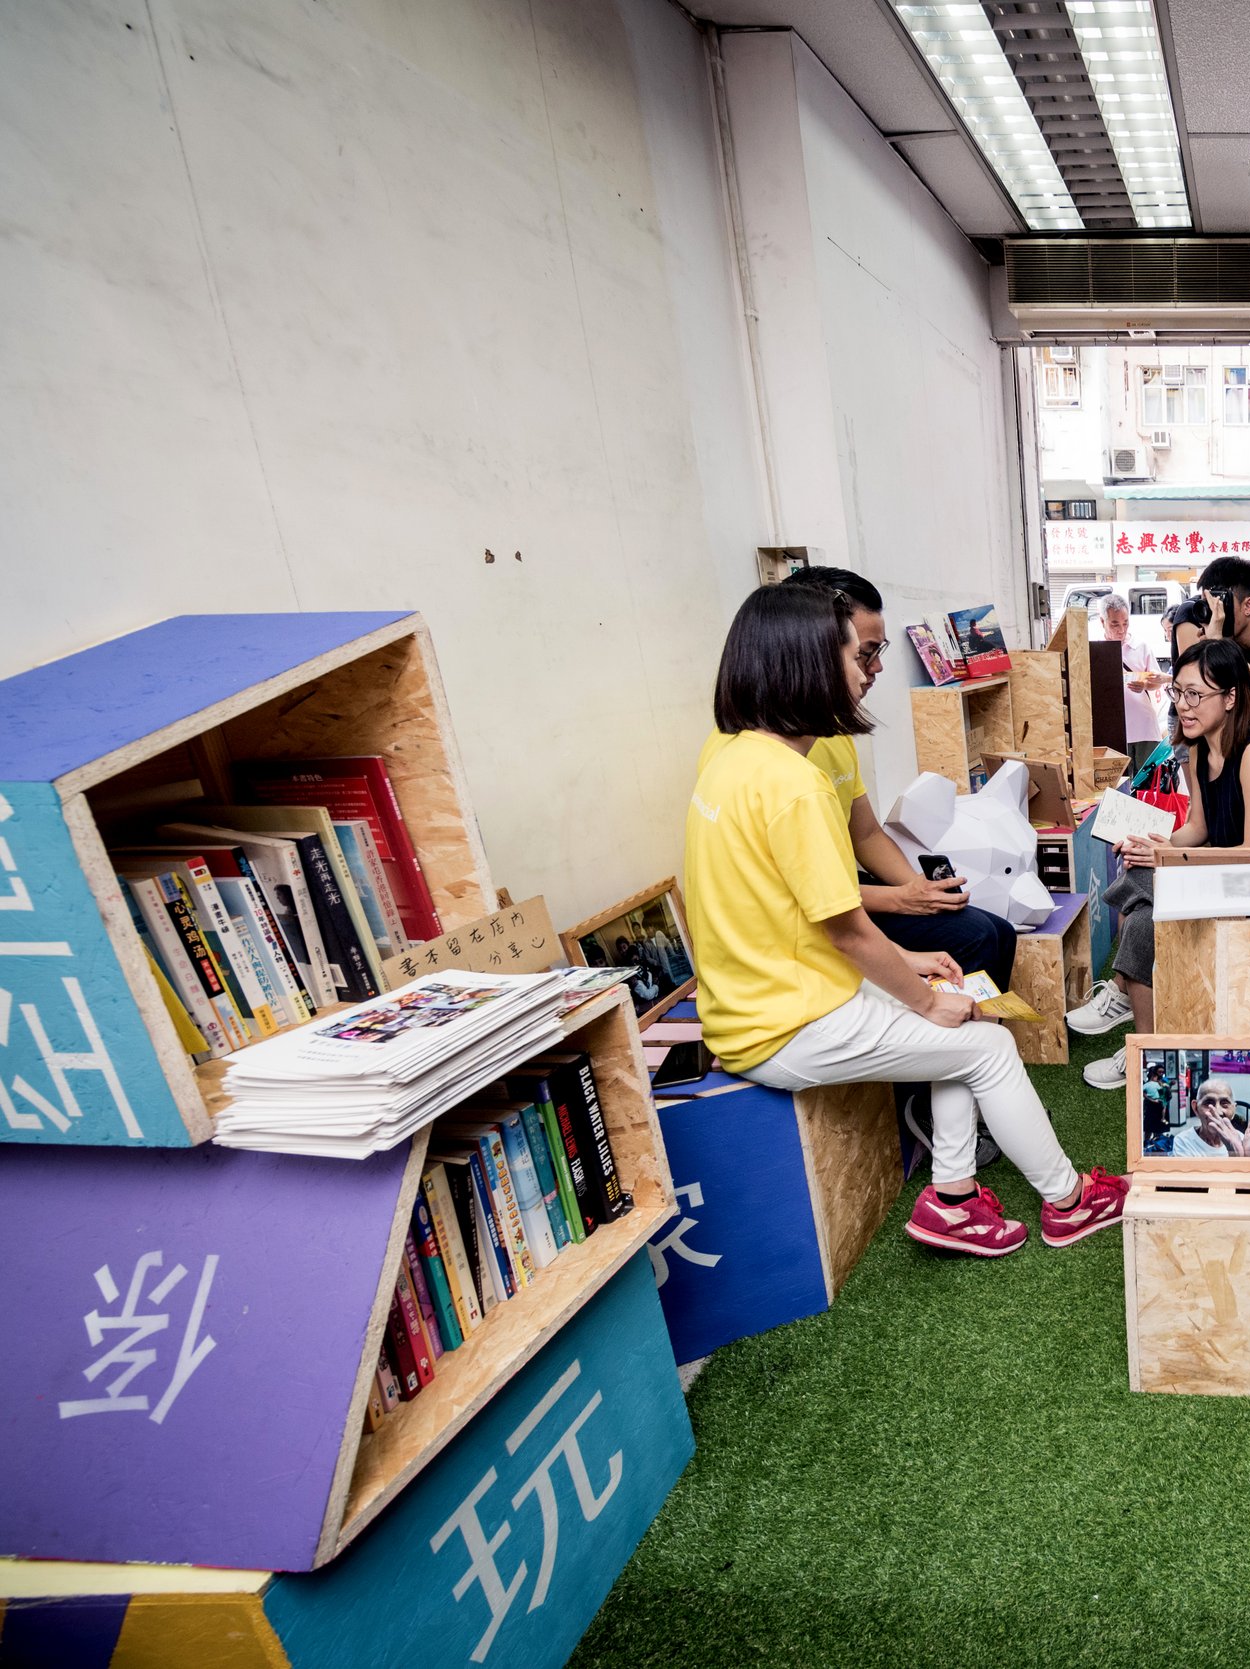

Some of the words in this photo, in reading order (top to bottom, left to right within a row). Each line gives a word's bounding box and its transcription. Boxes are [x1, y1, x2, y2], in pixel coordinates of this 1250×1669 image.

[311, 847, 341, 906] 走光再走光
[398, 912, 526, 977] 書本留在店內
[557, 1103, 573, 1138] MICHAEL
[564, 1134, 578, 1159] LEWIS
[579, 1064, 594, 1105] BLACK
[588, 1101, 606, 1142] WATER
[597, 1138, 614, 1177] LILIES
[58, 1250, 221, 1425] 係
[429, 1358, 624, 1663] 玩
